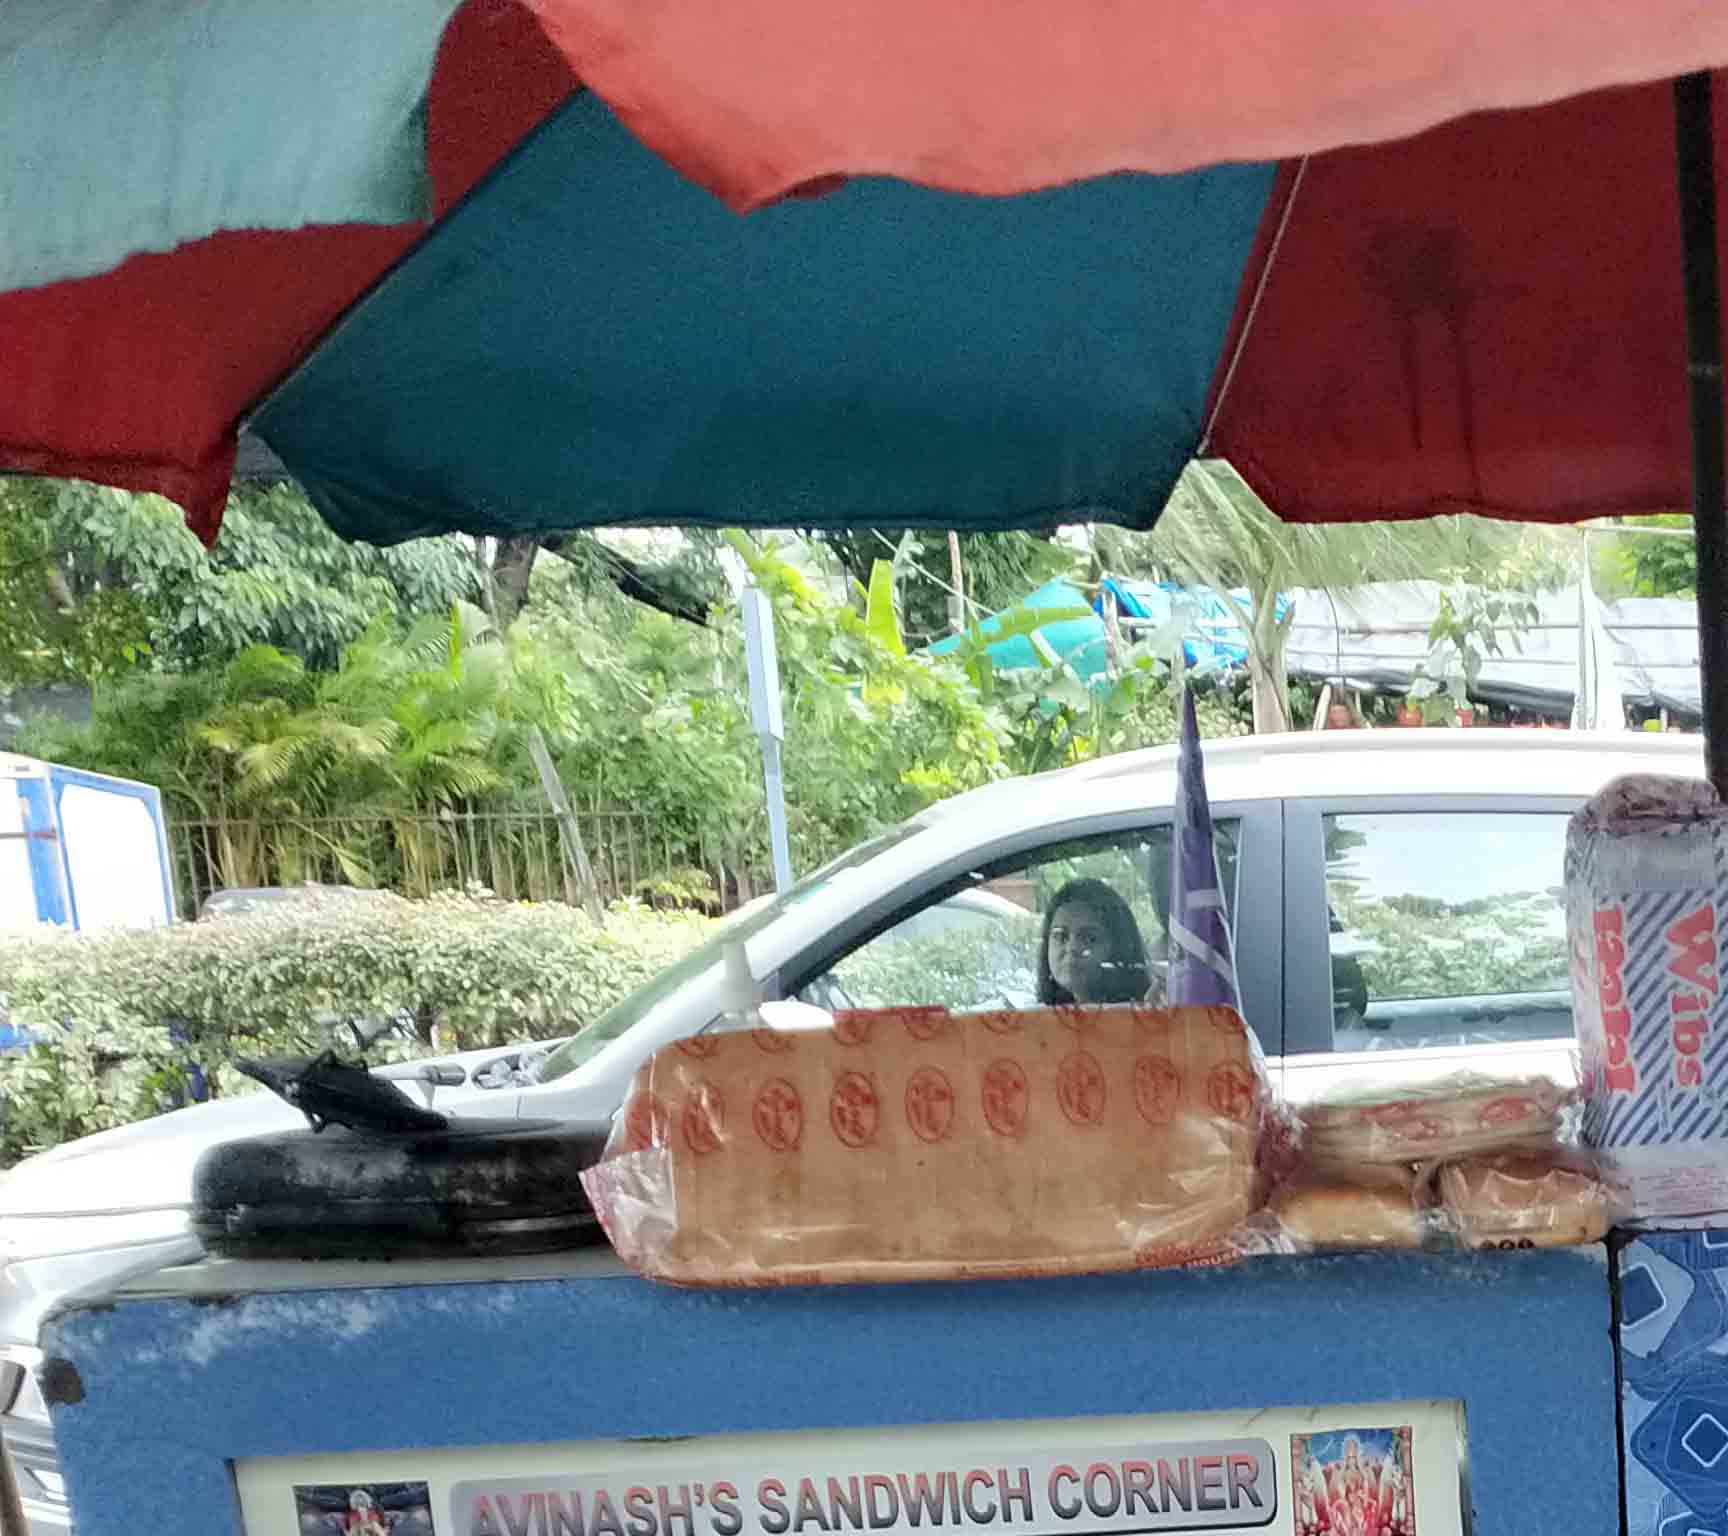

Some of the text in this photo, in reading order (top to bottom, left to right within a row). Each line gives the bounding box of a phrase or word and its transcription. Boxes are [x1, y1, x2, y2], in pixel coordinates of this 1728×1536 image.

[1665, 904, 1719, 1087] Wibs
[757, 1466, 1035, 1535] SANDWICH
[1047, 1454, 1264, 1520] CORNER
